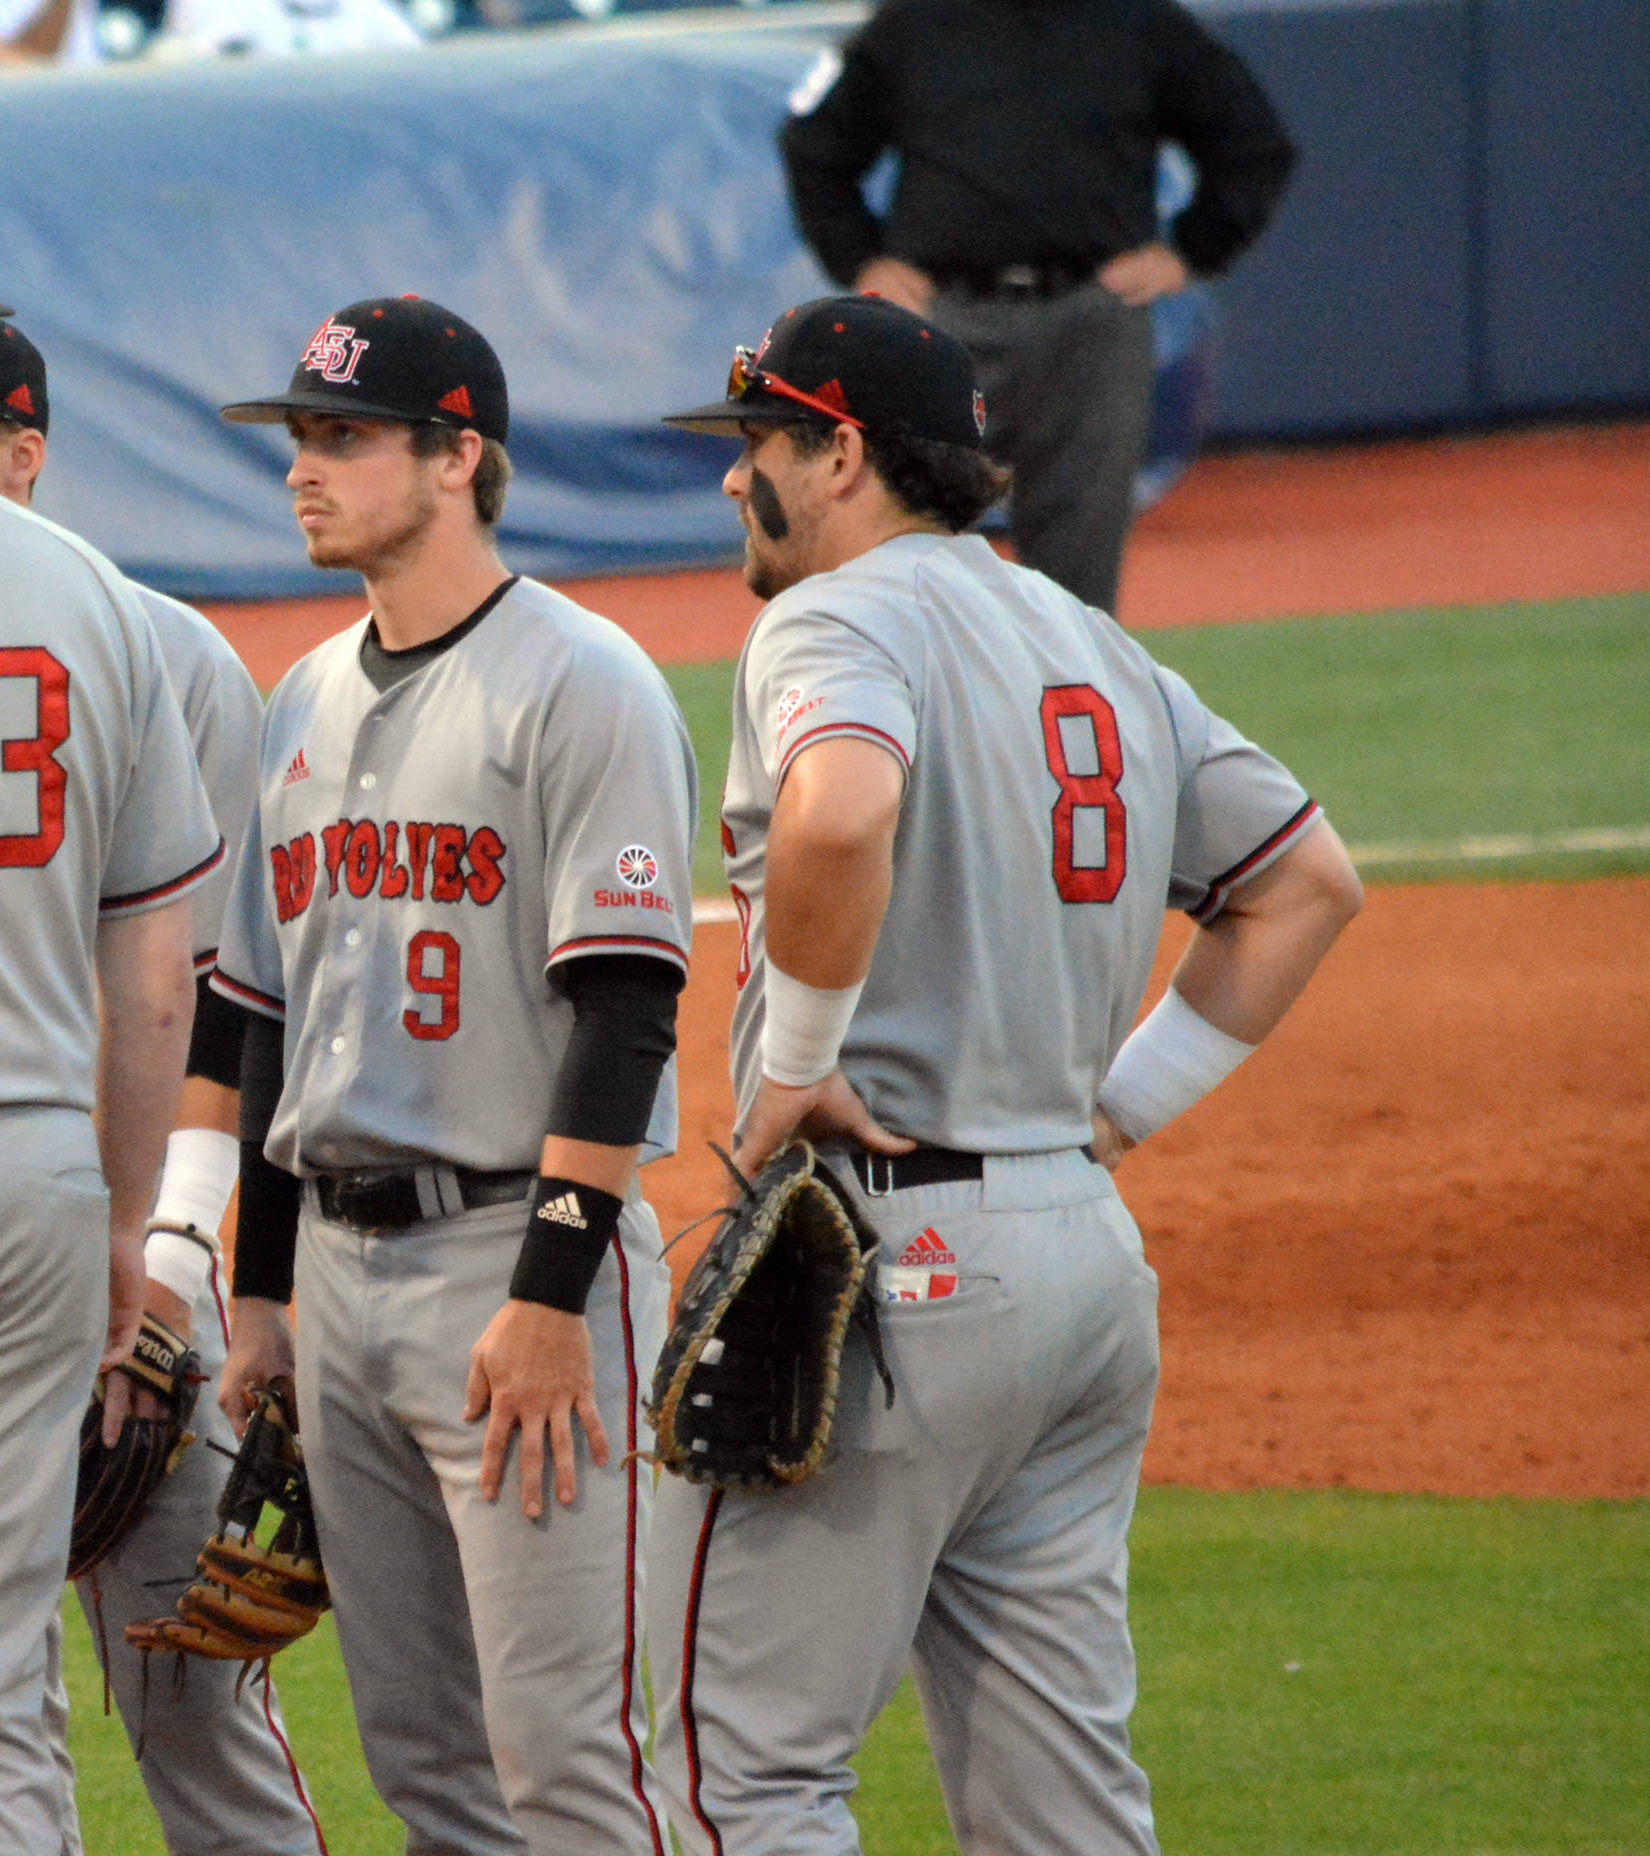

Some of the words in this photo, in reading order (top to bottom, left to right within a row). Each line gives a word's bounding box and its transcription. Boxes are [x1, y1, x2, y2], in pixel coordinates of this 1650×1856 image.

[300, 314, 370, 384] ASU
[1039, 683, 1127, 904] 8
[593, 889, 637, 908] SUN
[402, 929, 462, 1042] 9
[537, 1207, 588, 1230] adidas
[898, 1251, 957, 1267] adidas
